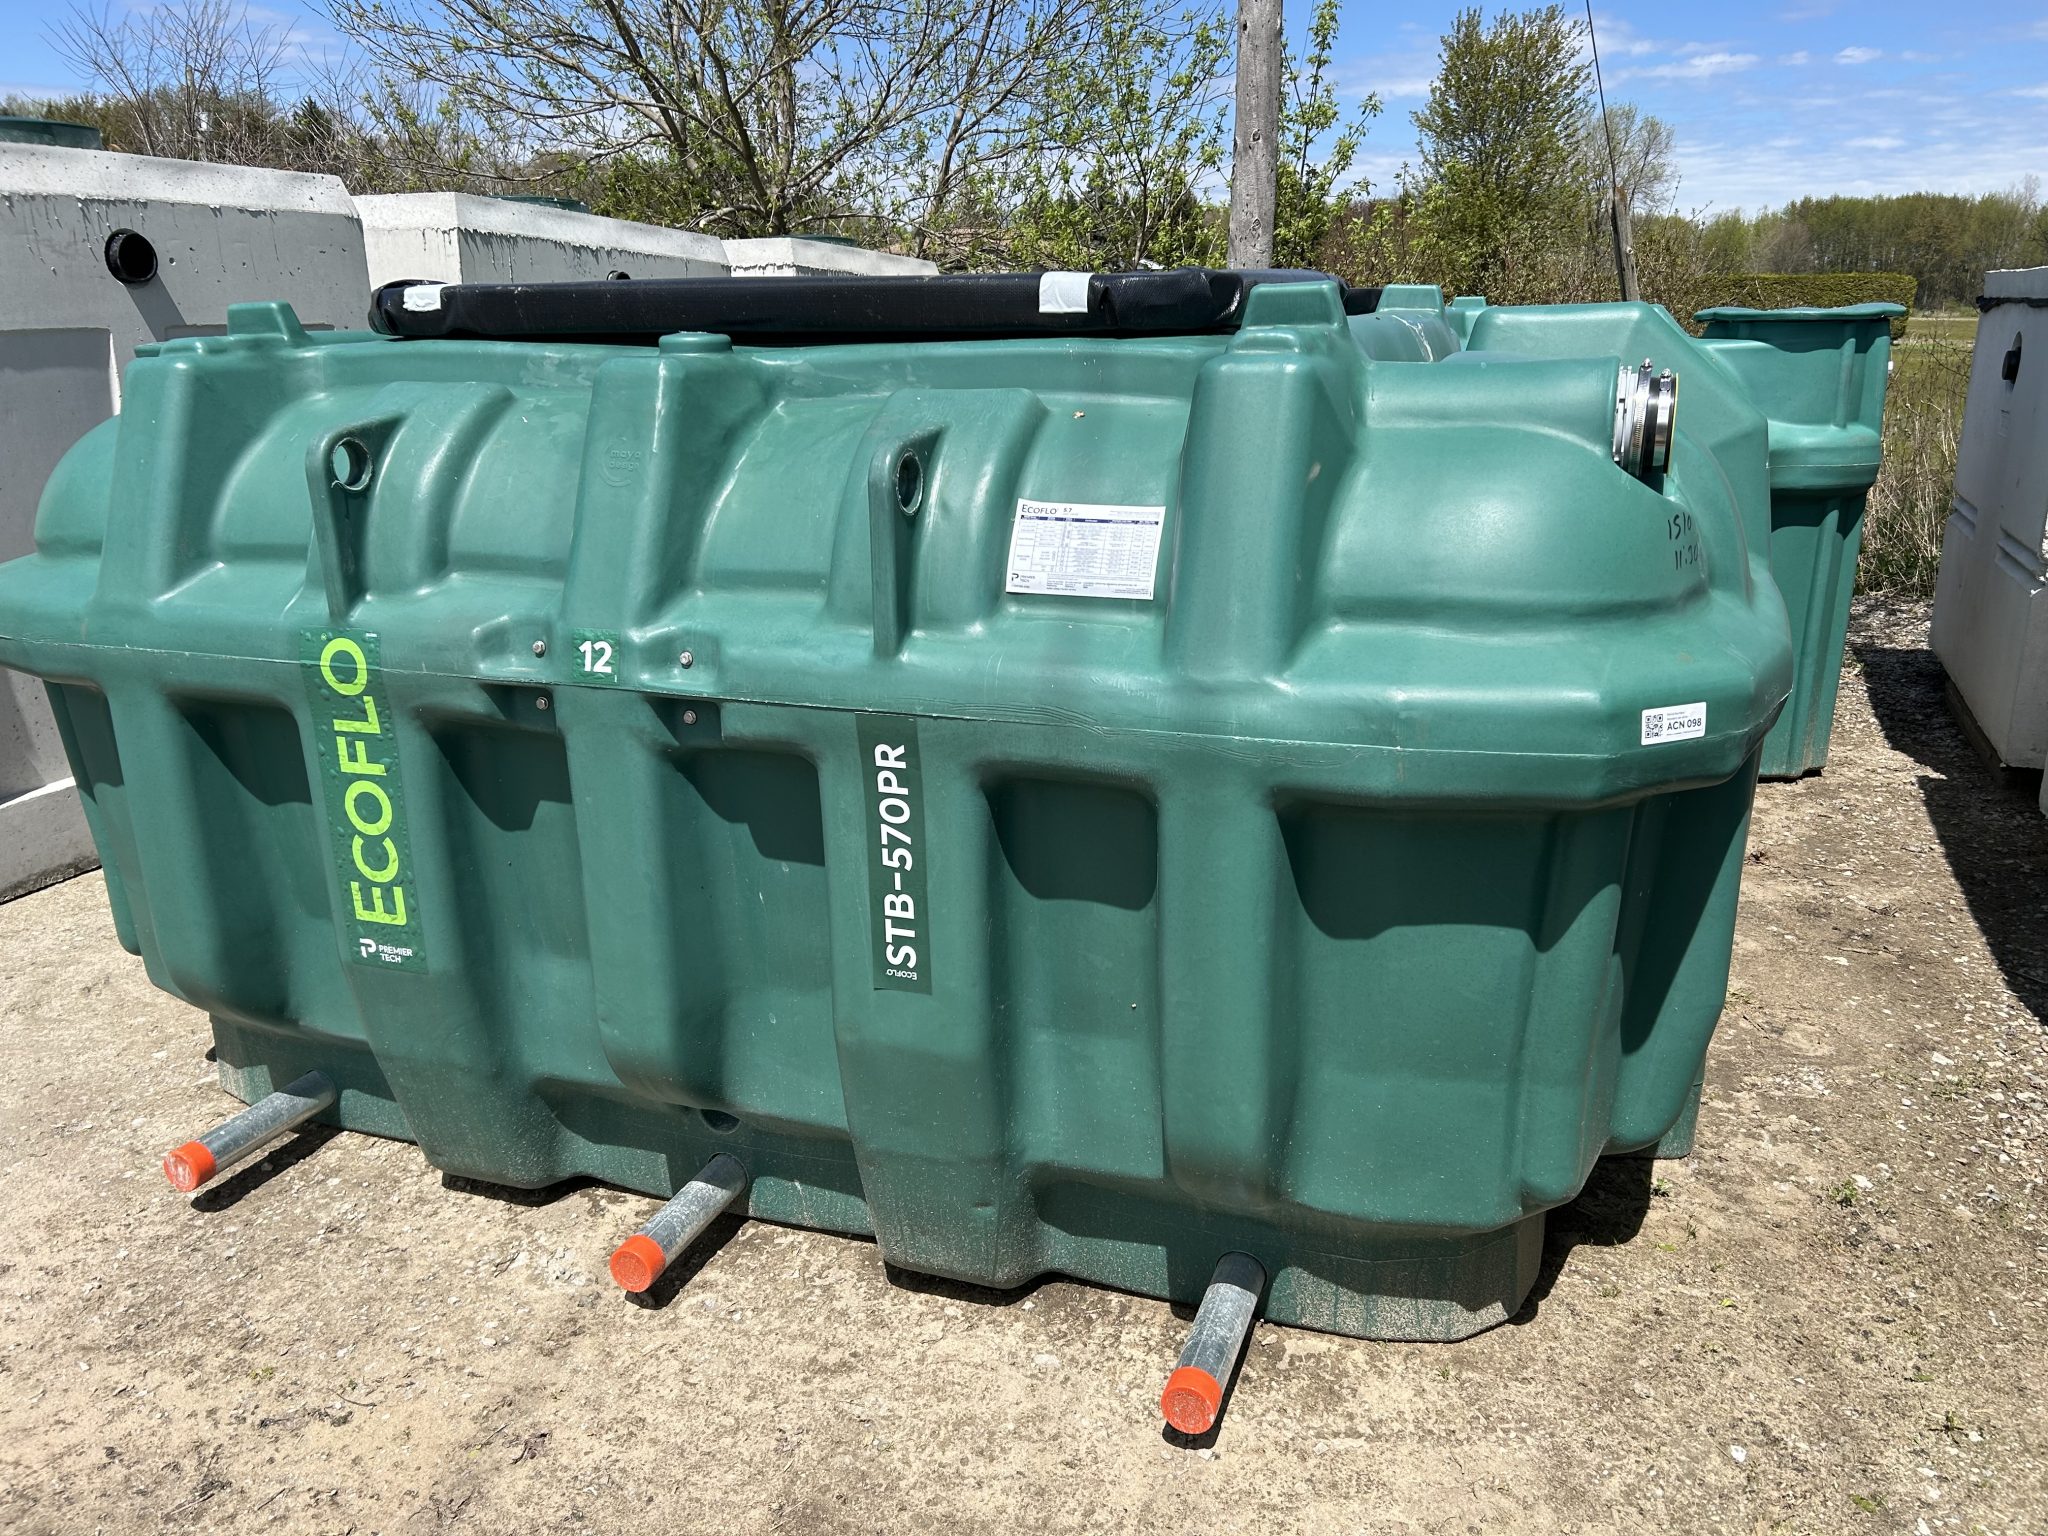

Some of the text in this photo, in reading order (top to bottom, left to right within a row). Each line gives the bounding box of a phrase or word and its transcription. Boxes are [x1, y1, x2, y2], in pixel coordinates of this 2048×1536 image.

[1021, 504, 1057, 515] ECOFLO
[578, 640, 612, 674] 12
[1666, 720, 1685, 731] ACN
[1686, 717, 1702, 728] 098
[319, 637, 408, 926] ECOFLO
[874, 743, 917, 969] STB-570PR
[378, 944, 413, 957] PREMIER
[380, 953, 402, 963] TECH
[886, 968, 918, 981] ECOFLO
